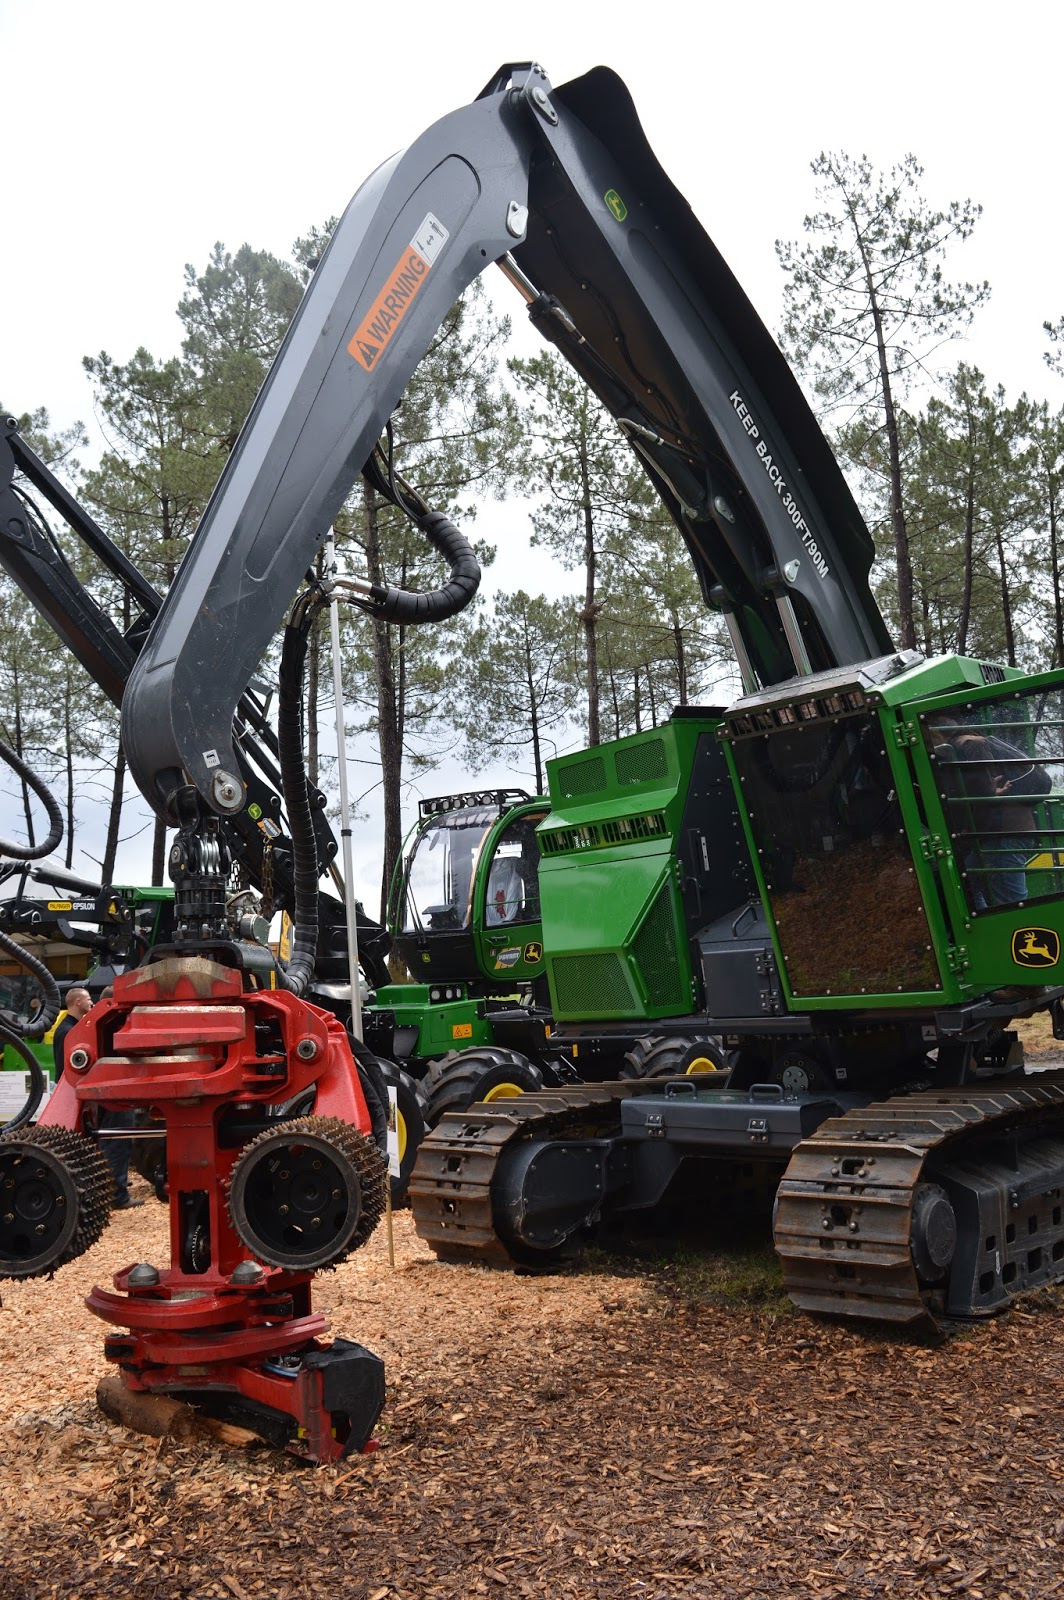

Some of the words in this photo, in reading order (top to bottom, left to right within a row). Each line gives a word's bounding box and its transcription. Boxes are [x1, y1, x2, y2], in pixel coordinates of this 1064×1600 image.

[367, 255, 426, 343] WARNING
[729, 390, 760, 439] KEEP
[755, 440, 787, 494] BACK
[782, 493, 830, 579] 300FT/90M
[73, 902, 96, 910] EPSILON
